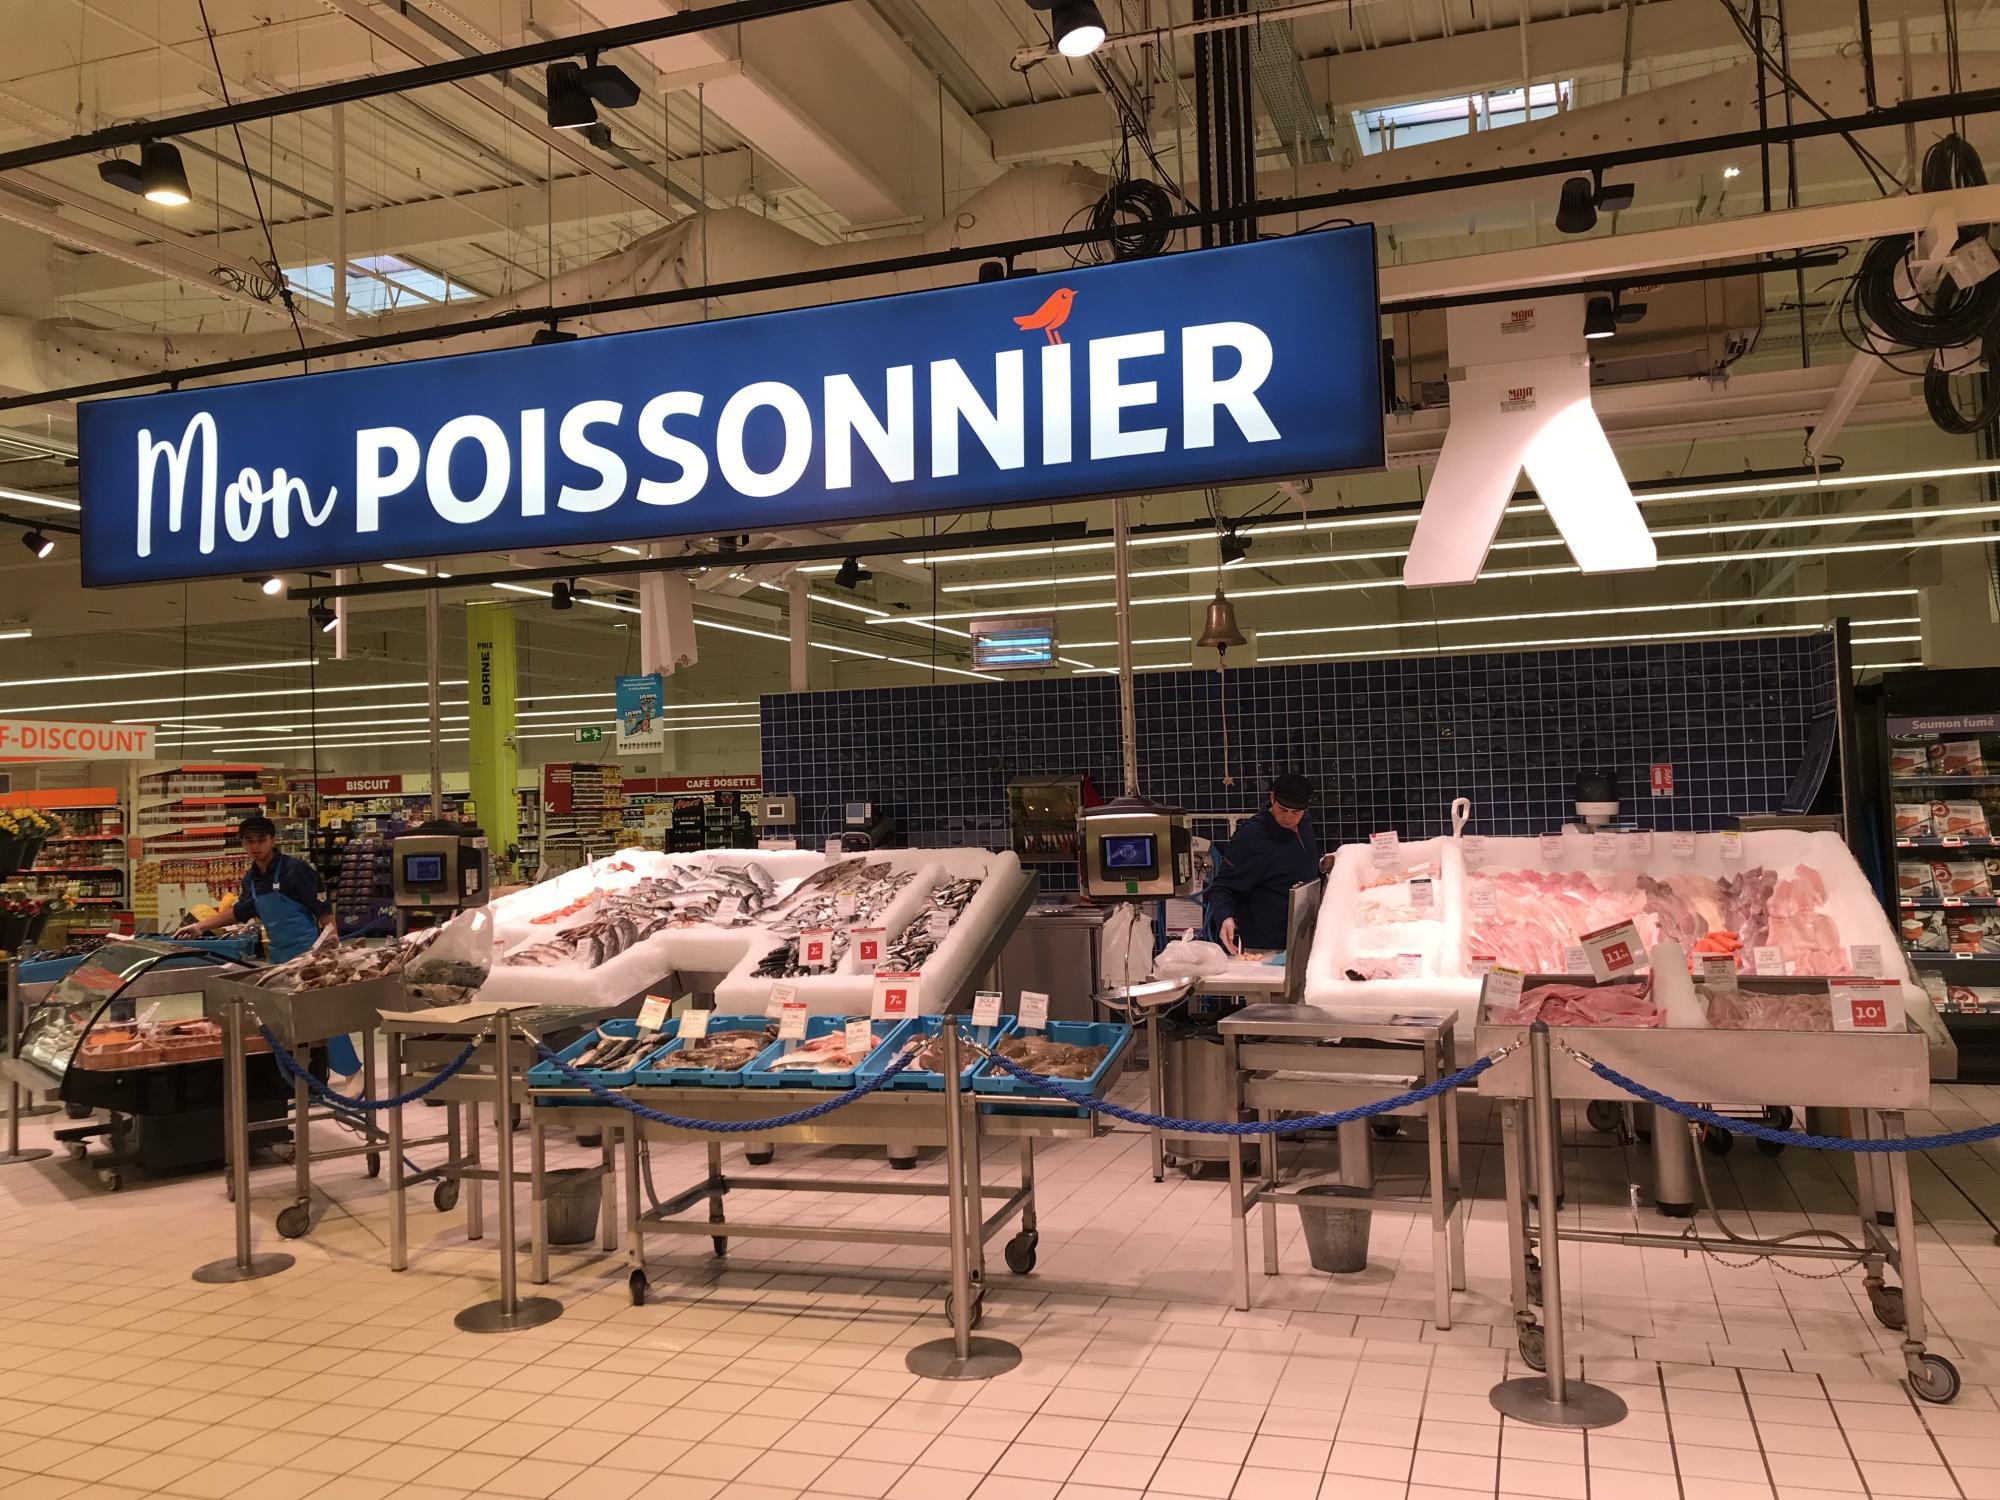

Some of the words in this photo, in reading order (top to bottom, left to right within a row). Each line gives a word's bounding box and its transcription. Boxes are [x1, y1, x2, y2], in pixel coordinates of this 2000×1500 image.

[137, 411, 338, 558] Mon
[356, 321, 1281, 534] POISSONNIER
[477, 642, 493, 650] PRIX
[481, 652, 491, 706] BORNE
[1912, 719, 1961, 730] Saumon
[1963, 716, 1995, 727] fumé
[346, 779, 390, 791] BISCUIT
[686, 777, 711, 789] CAFÉ
[713, 777, 756, 788] DOSETTE
